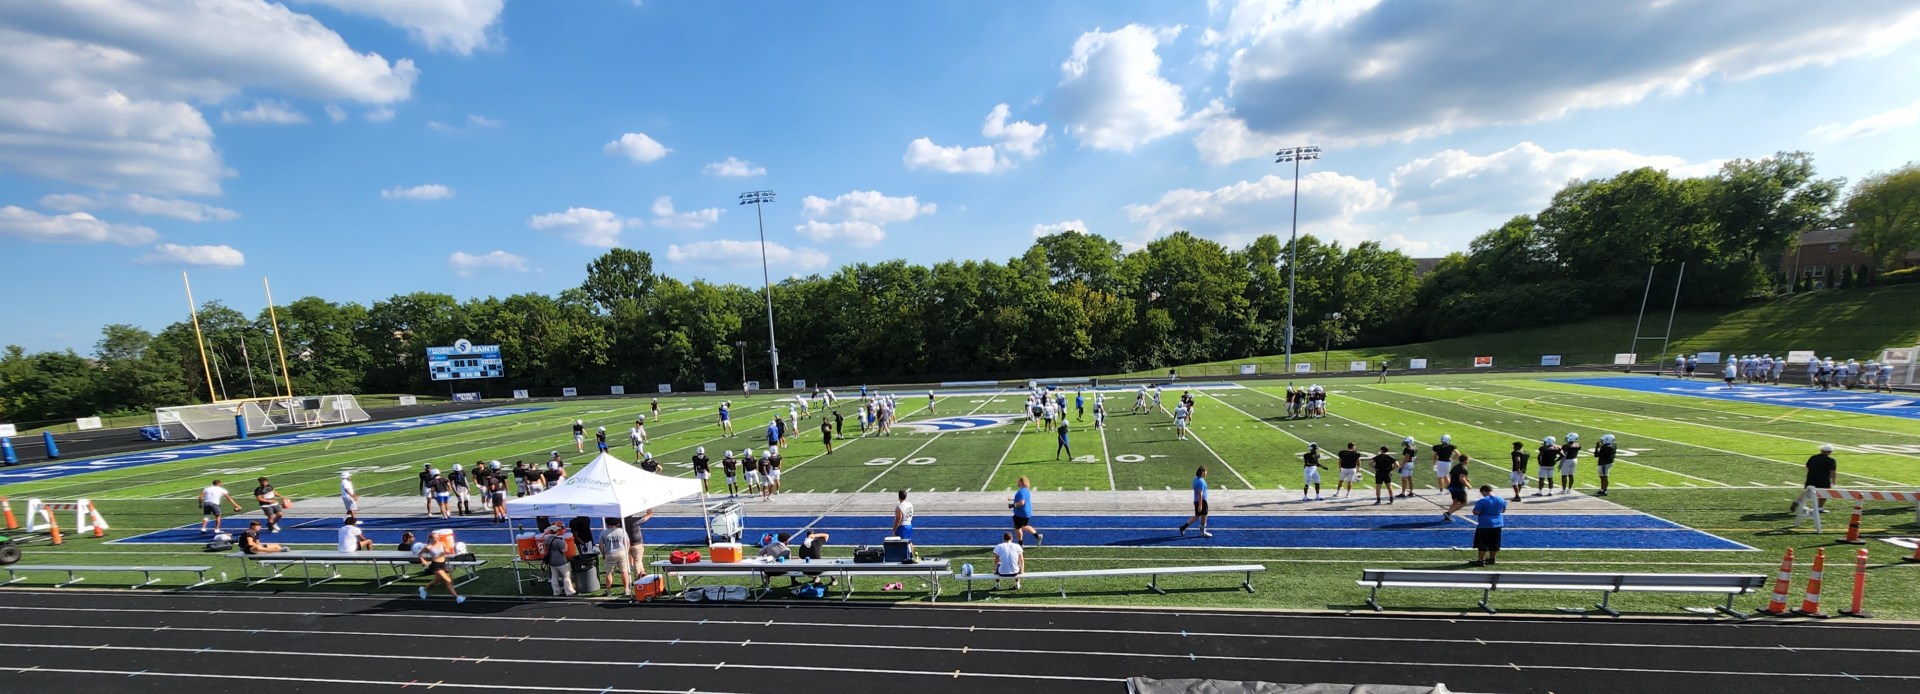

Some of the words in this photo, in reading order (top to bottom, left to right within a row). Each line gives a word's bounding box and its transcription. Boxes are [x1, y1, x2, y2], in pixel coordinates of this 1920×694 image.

[471, 345, 500, 353] SAINTS
[863, 456, 937, 466] 50
[1070, 454, 1146, 463] 40
